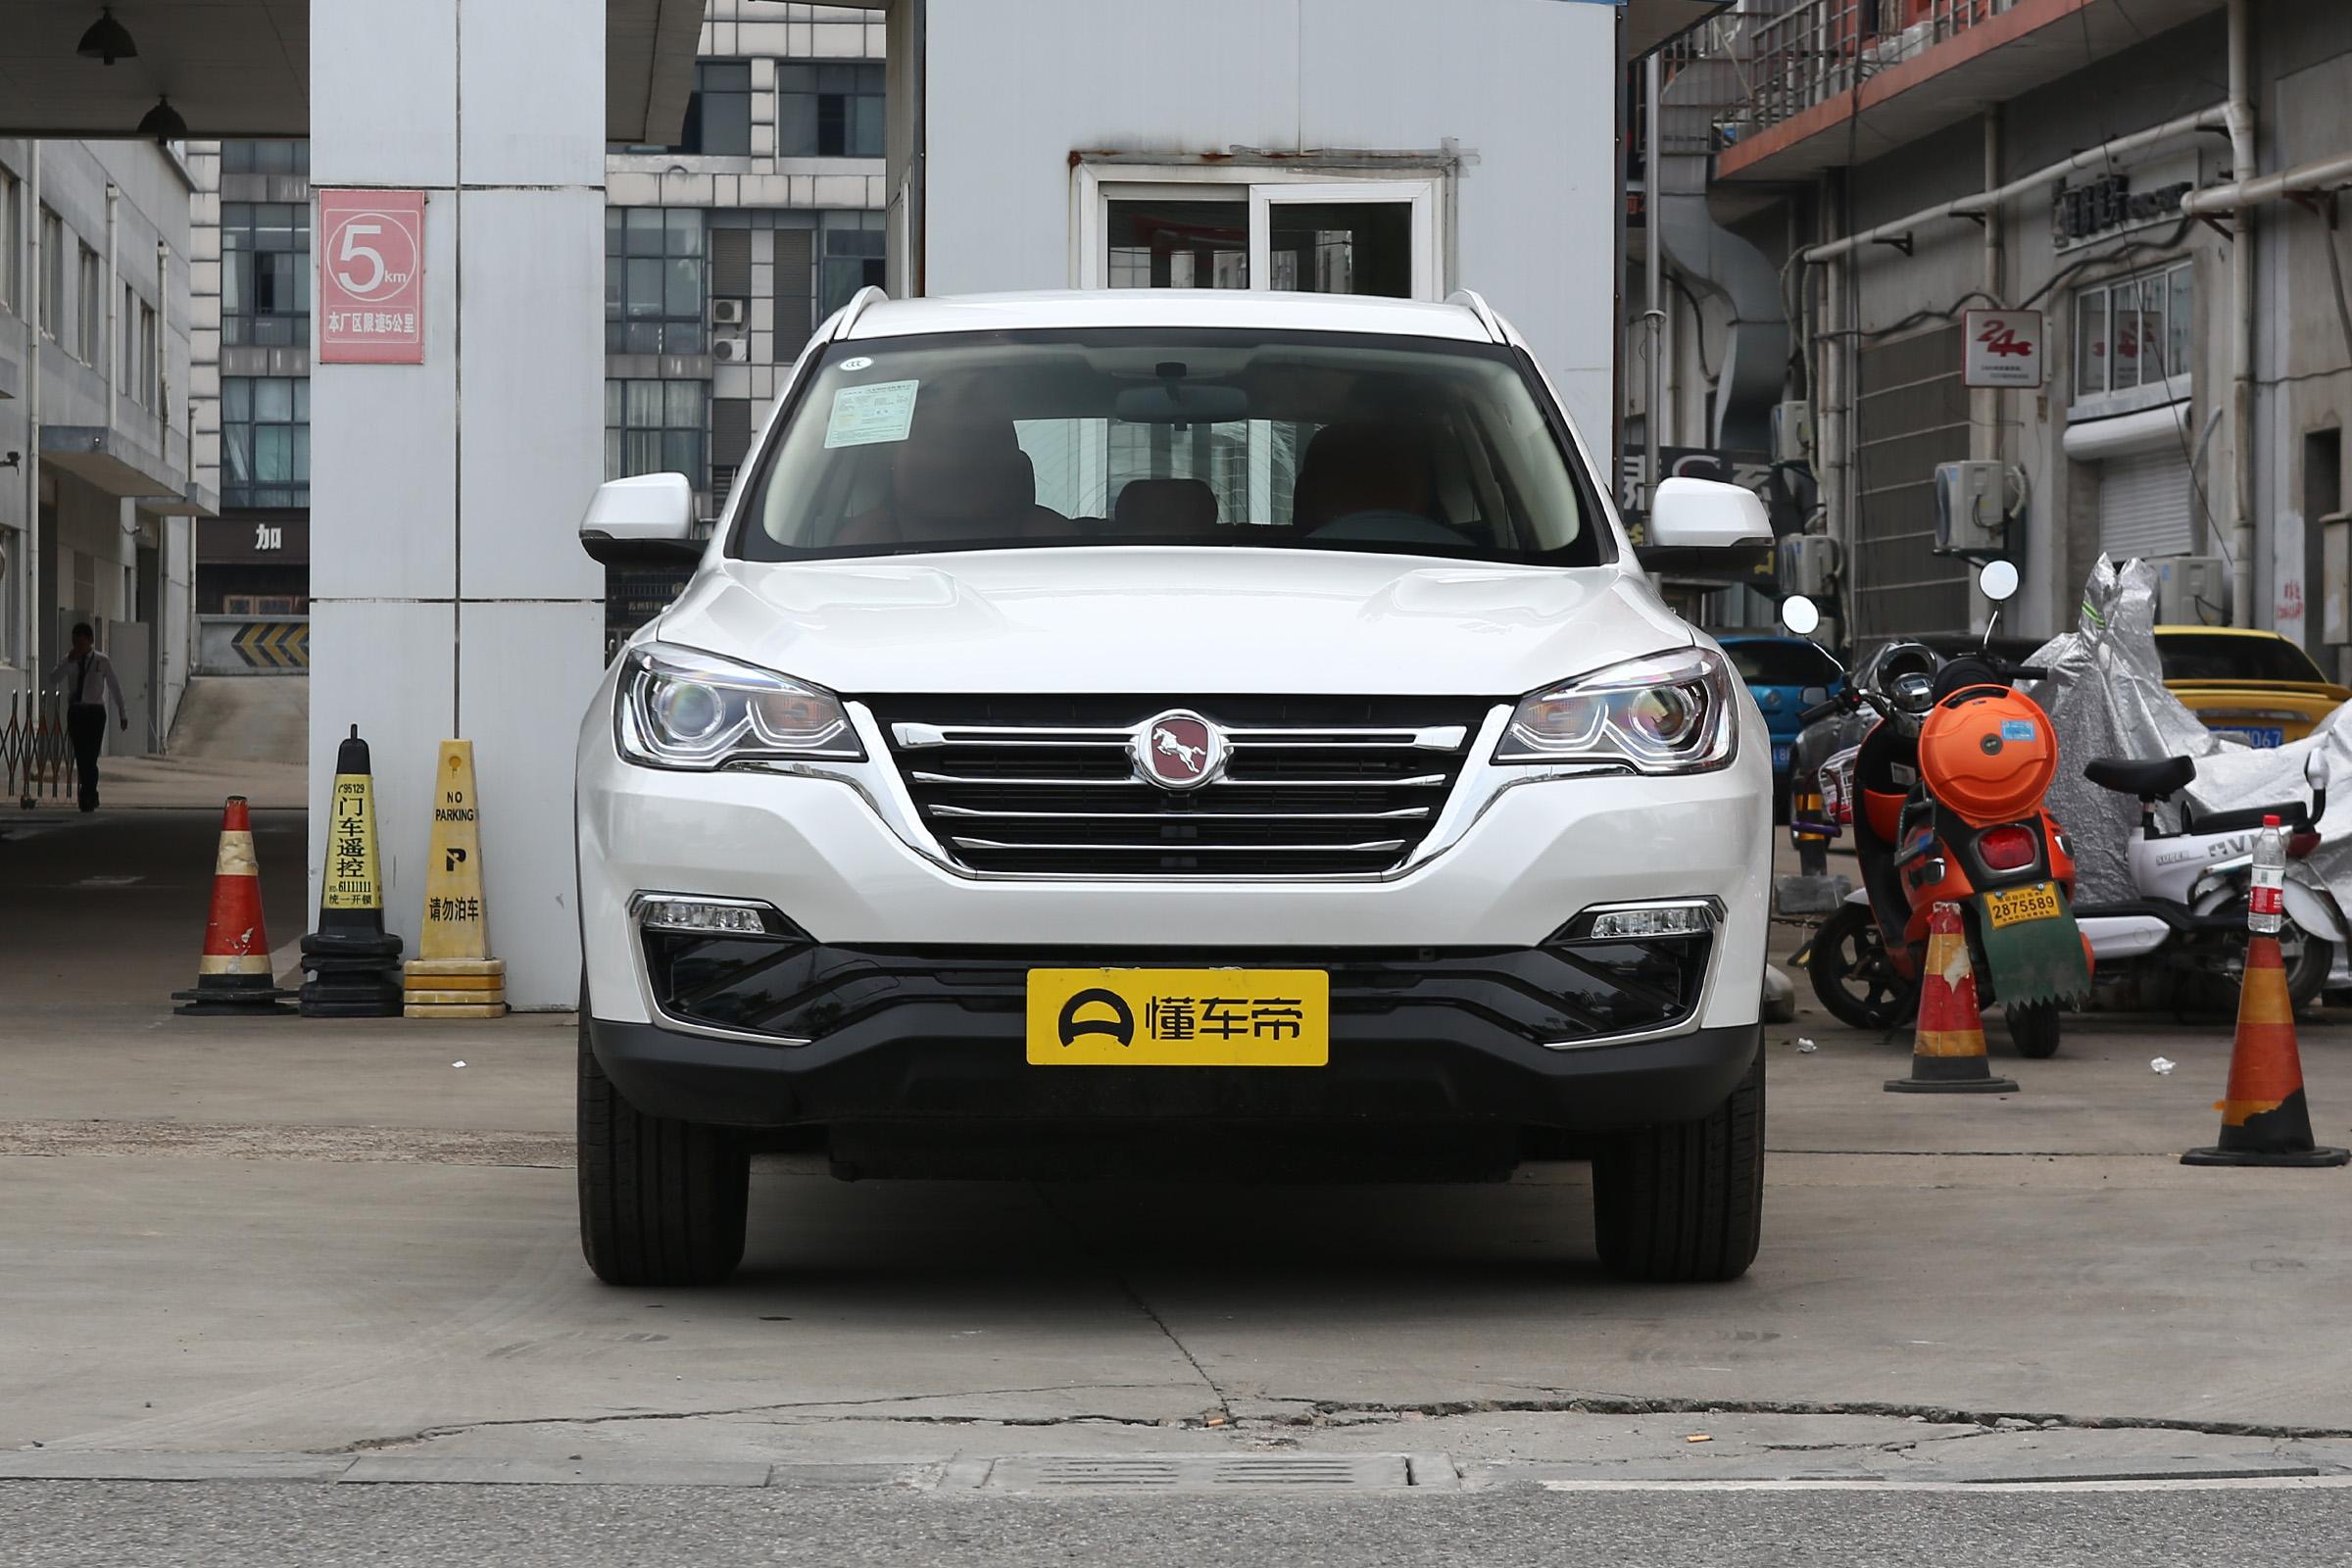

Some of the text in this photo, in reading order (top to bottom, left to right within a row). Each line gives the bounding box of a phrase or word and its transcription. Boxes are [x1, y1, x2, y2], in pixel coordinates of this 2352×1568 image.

[339, 224, 407, 293] 5 km
[328, 312, 415, 333] 本厂区限速5公里
[1976, 319, 2026, 358] 24
[256, 523, 281, 550] 加
[447, 791, 463, 804] NO
[435, 808, 474, 821] PARKING
[446, 848, 466, 871] P
[429, 897, 478, 922] 请勿泊车
[1992, 896, 2055, 919] 2875589
[1146, 996, 1302, 1040] 懂车帝
